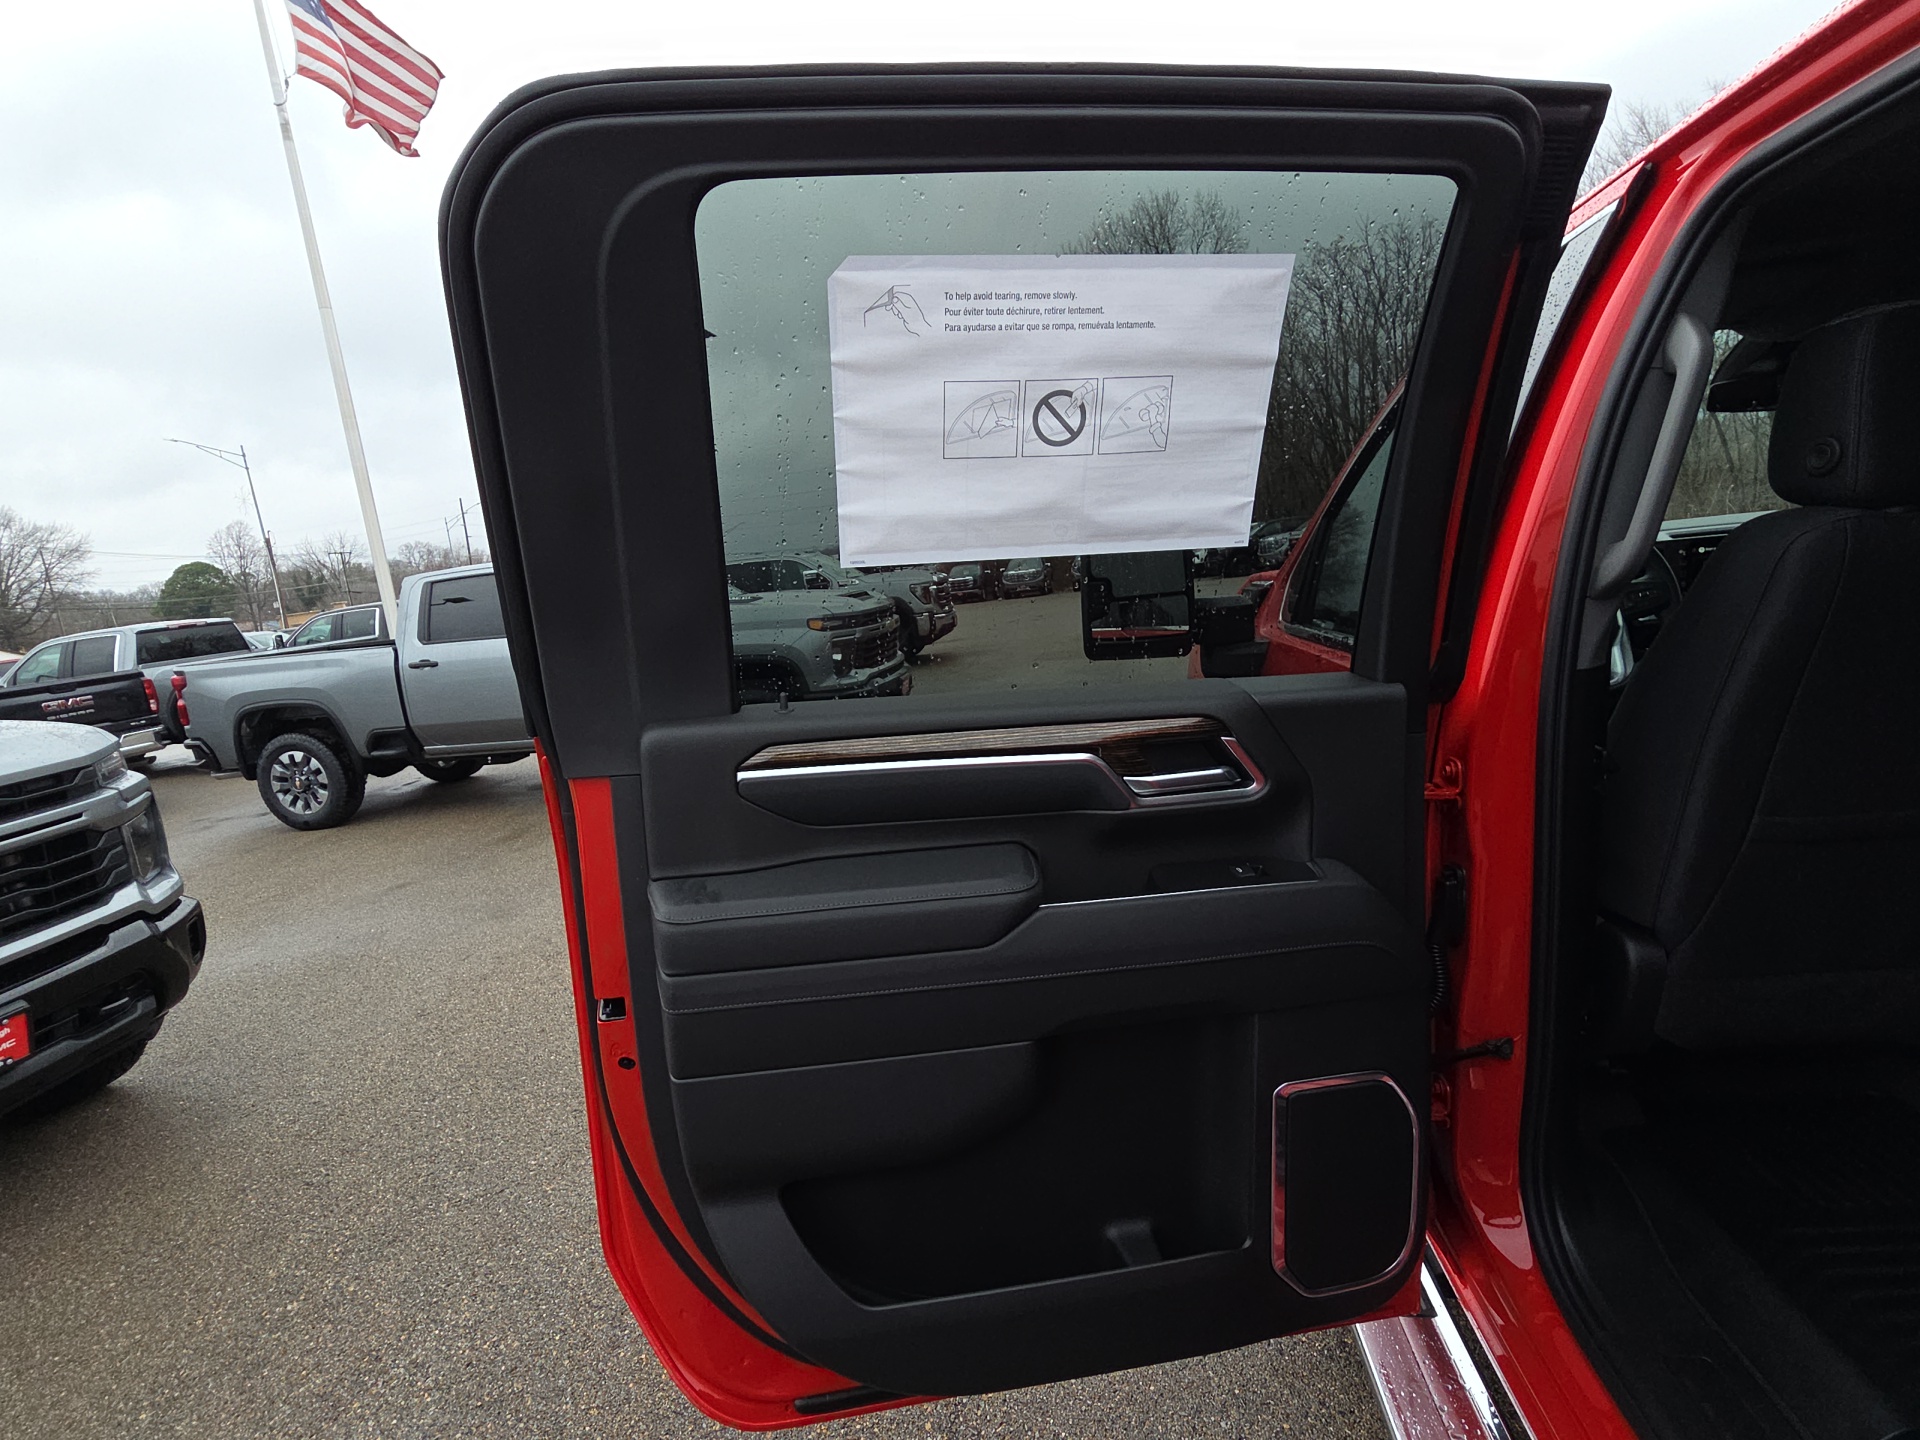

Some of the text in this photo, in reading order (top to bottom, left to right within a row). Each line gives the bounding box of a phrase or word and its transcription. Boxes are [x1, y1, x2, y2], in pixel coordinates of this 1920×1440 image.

[944, 291, 1078, 302] To help avoid tearing, remove slowly.
[944, 306, 1105, 316] Pour éviter toute déchirure, retirer lentement.
[944, 323, 961, 332] Para
[963, 322, 996, 333] ayudarse
[1004, 322, 1024, 331] evitar
[1026, 323, 1040, 332] que
[1041, 323, 1050, 331] se
[1051, 322, 1077, 332] rompa,
[1078, 320, 1115, 330] remuévala
[1115, 320, 1156, 329] lentamente.
[41, 695, 95, 712] GMC
